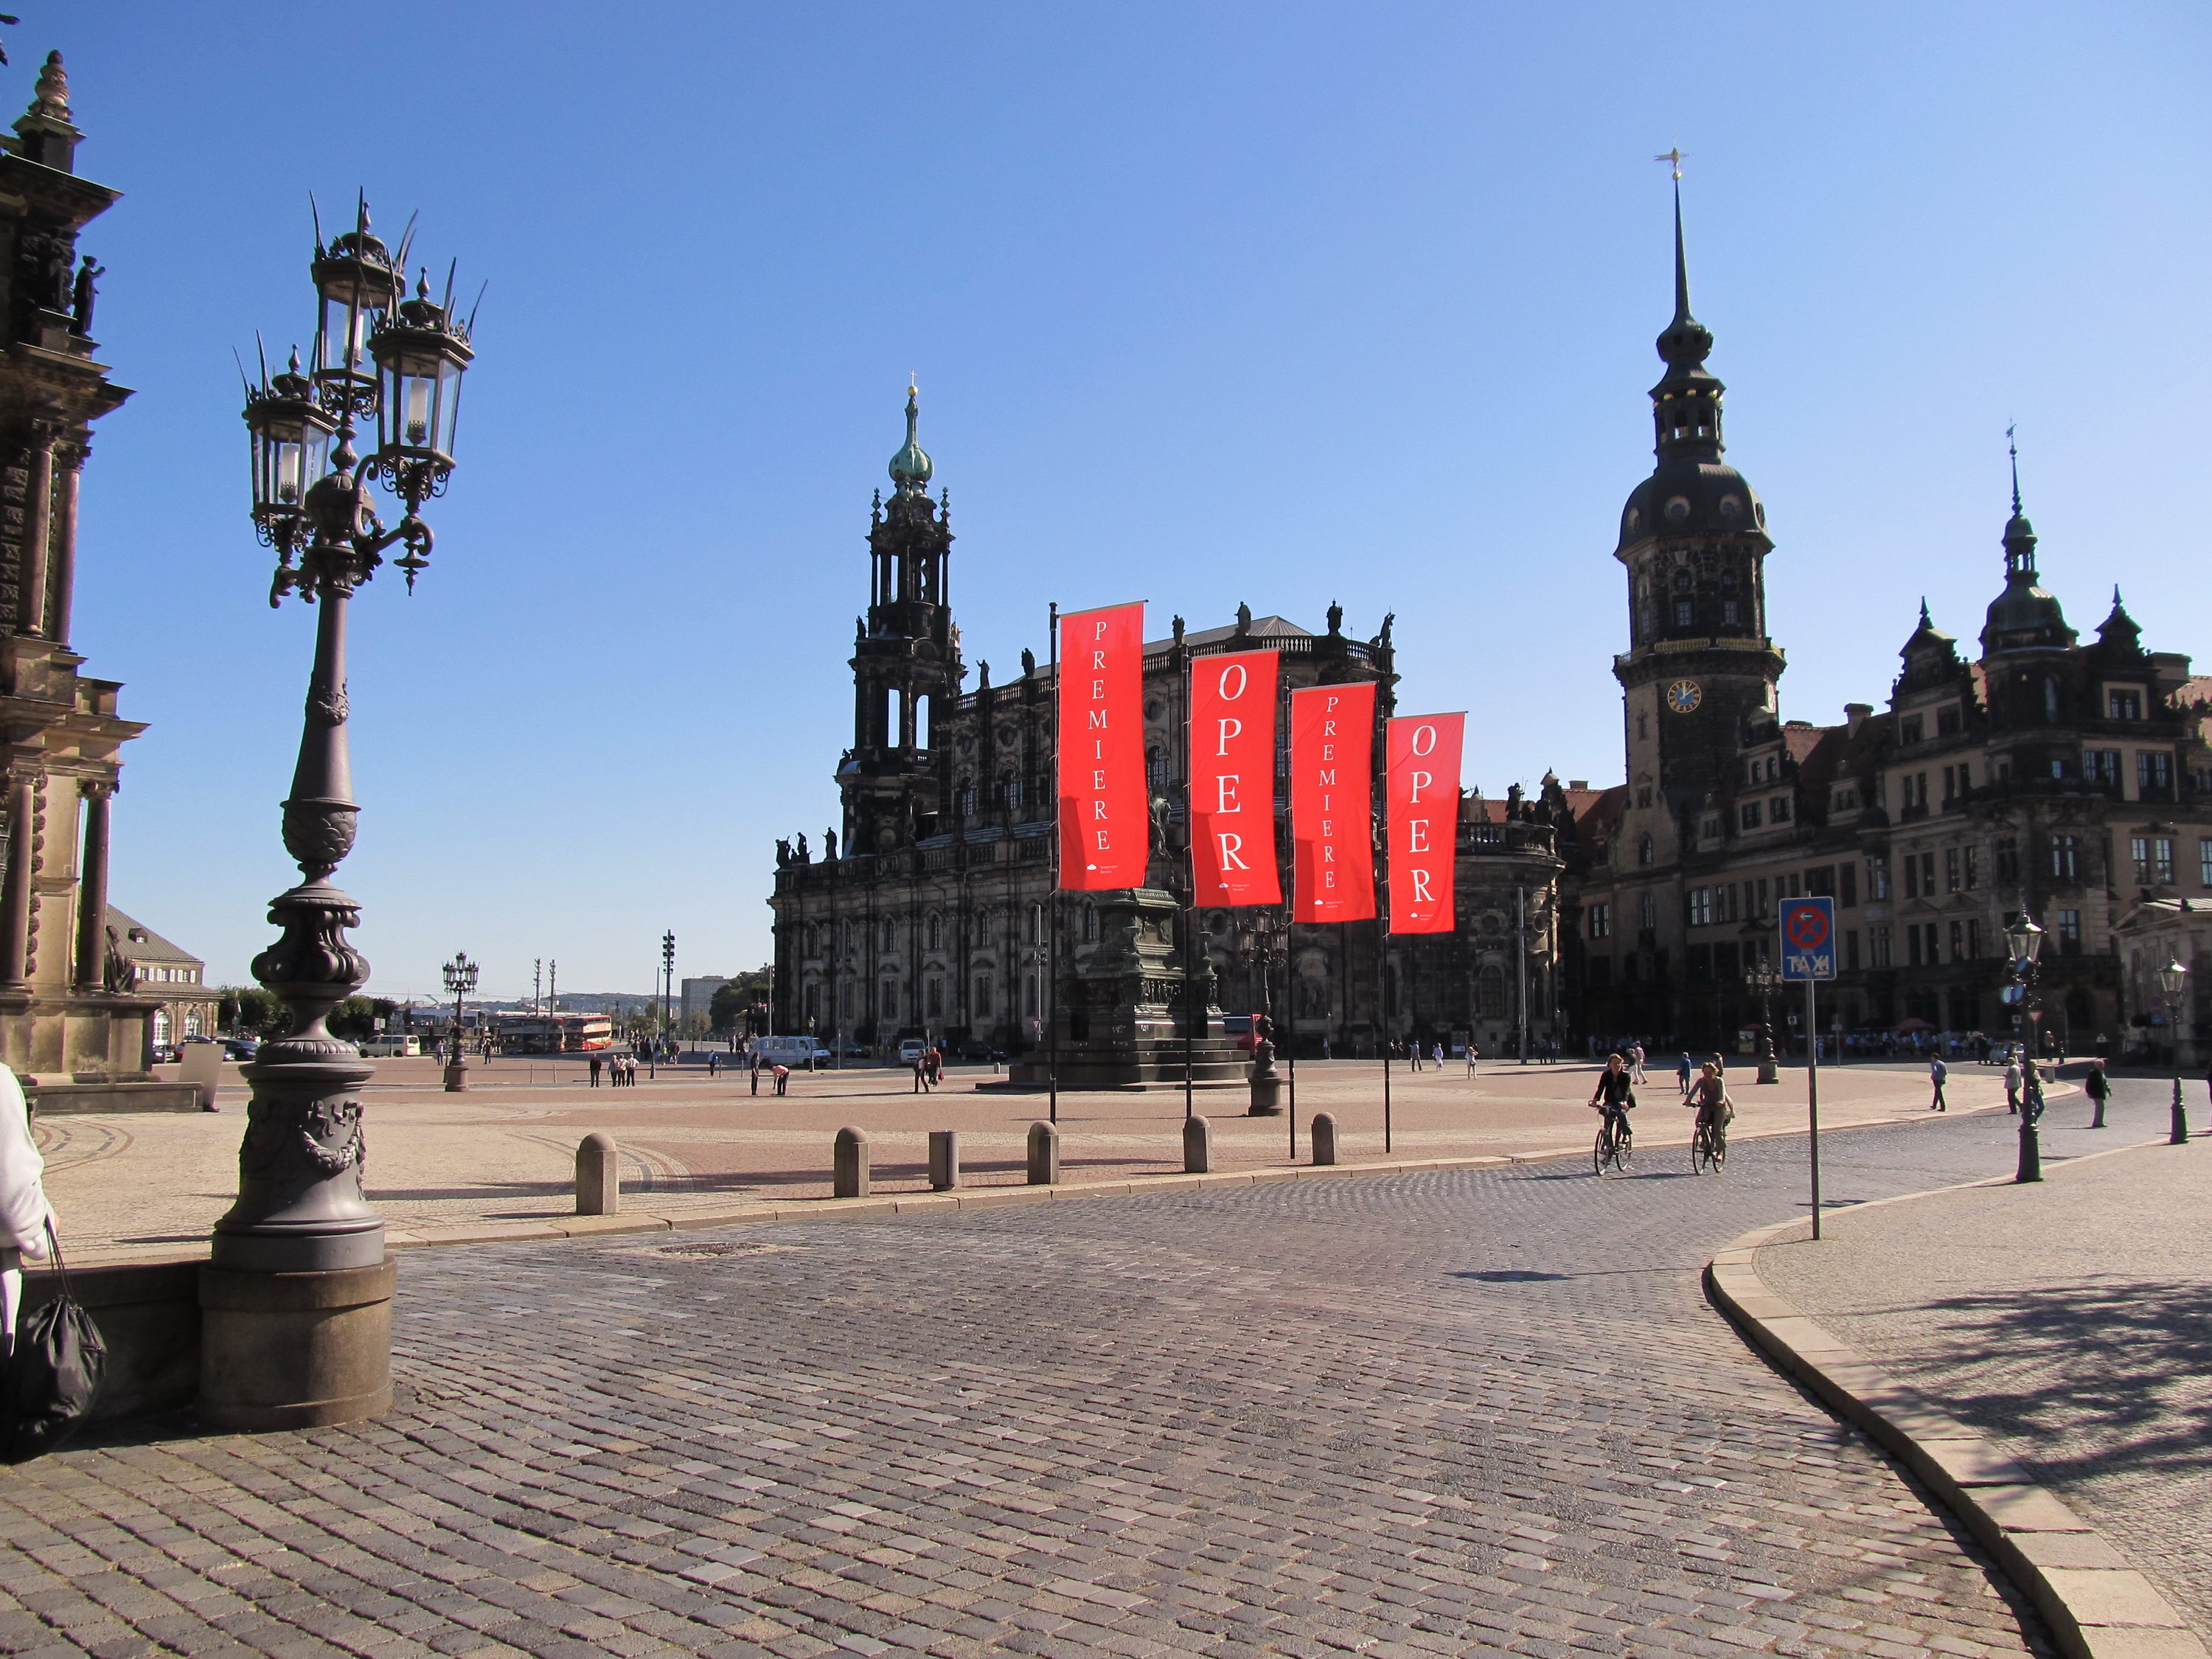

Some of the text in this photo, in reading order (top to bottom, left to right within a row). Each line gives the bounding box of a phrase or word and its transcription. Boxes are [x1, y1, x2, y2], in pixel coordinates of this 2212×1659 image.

[1088, 622, 1110, 849] PREMIERE
[1216, 664, 1250, 870] OPER
[1318, 697, 1338, 888] PREMIERE
[1409, 725, 1436, 902] OPER
[1787, 956, 1829, 972] TAXI
